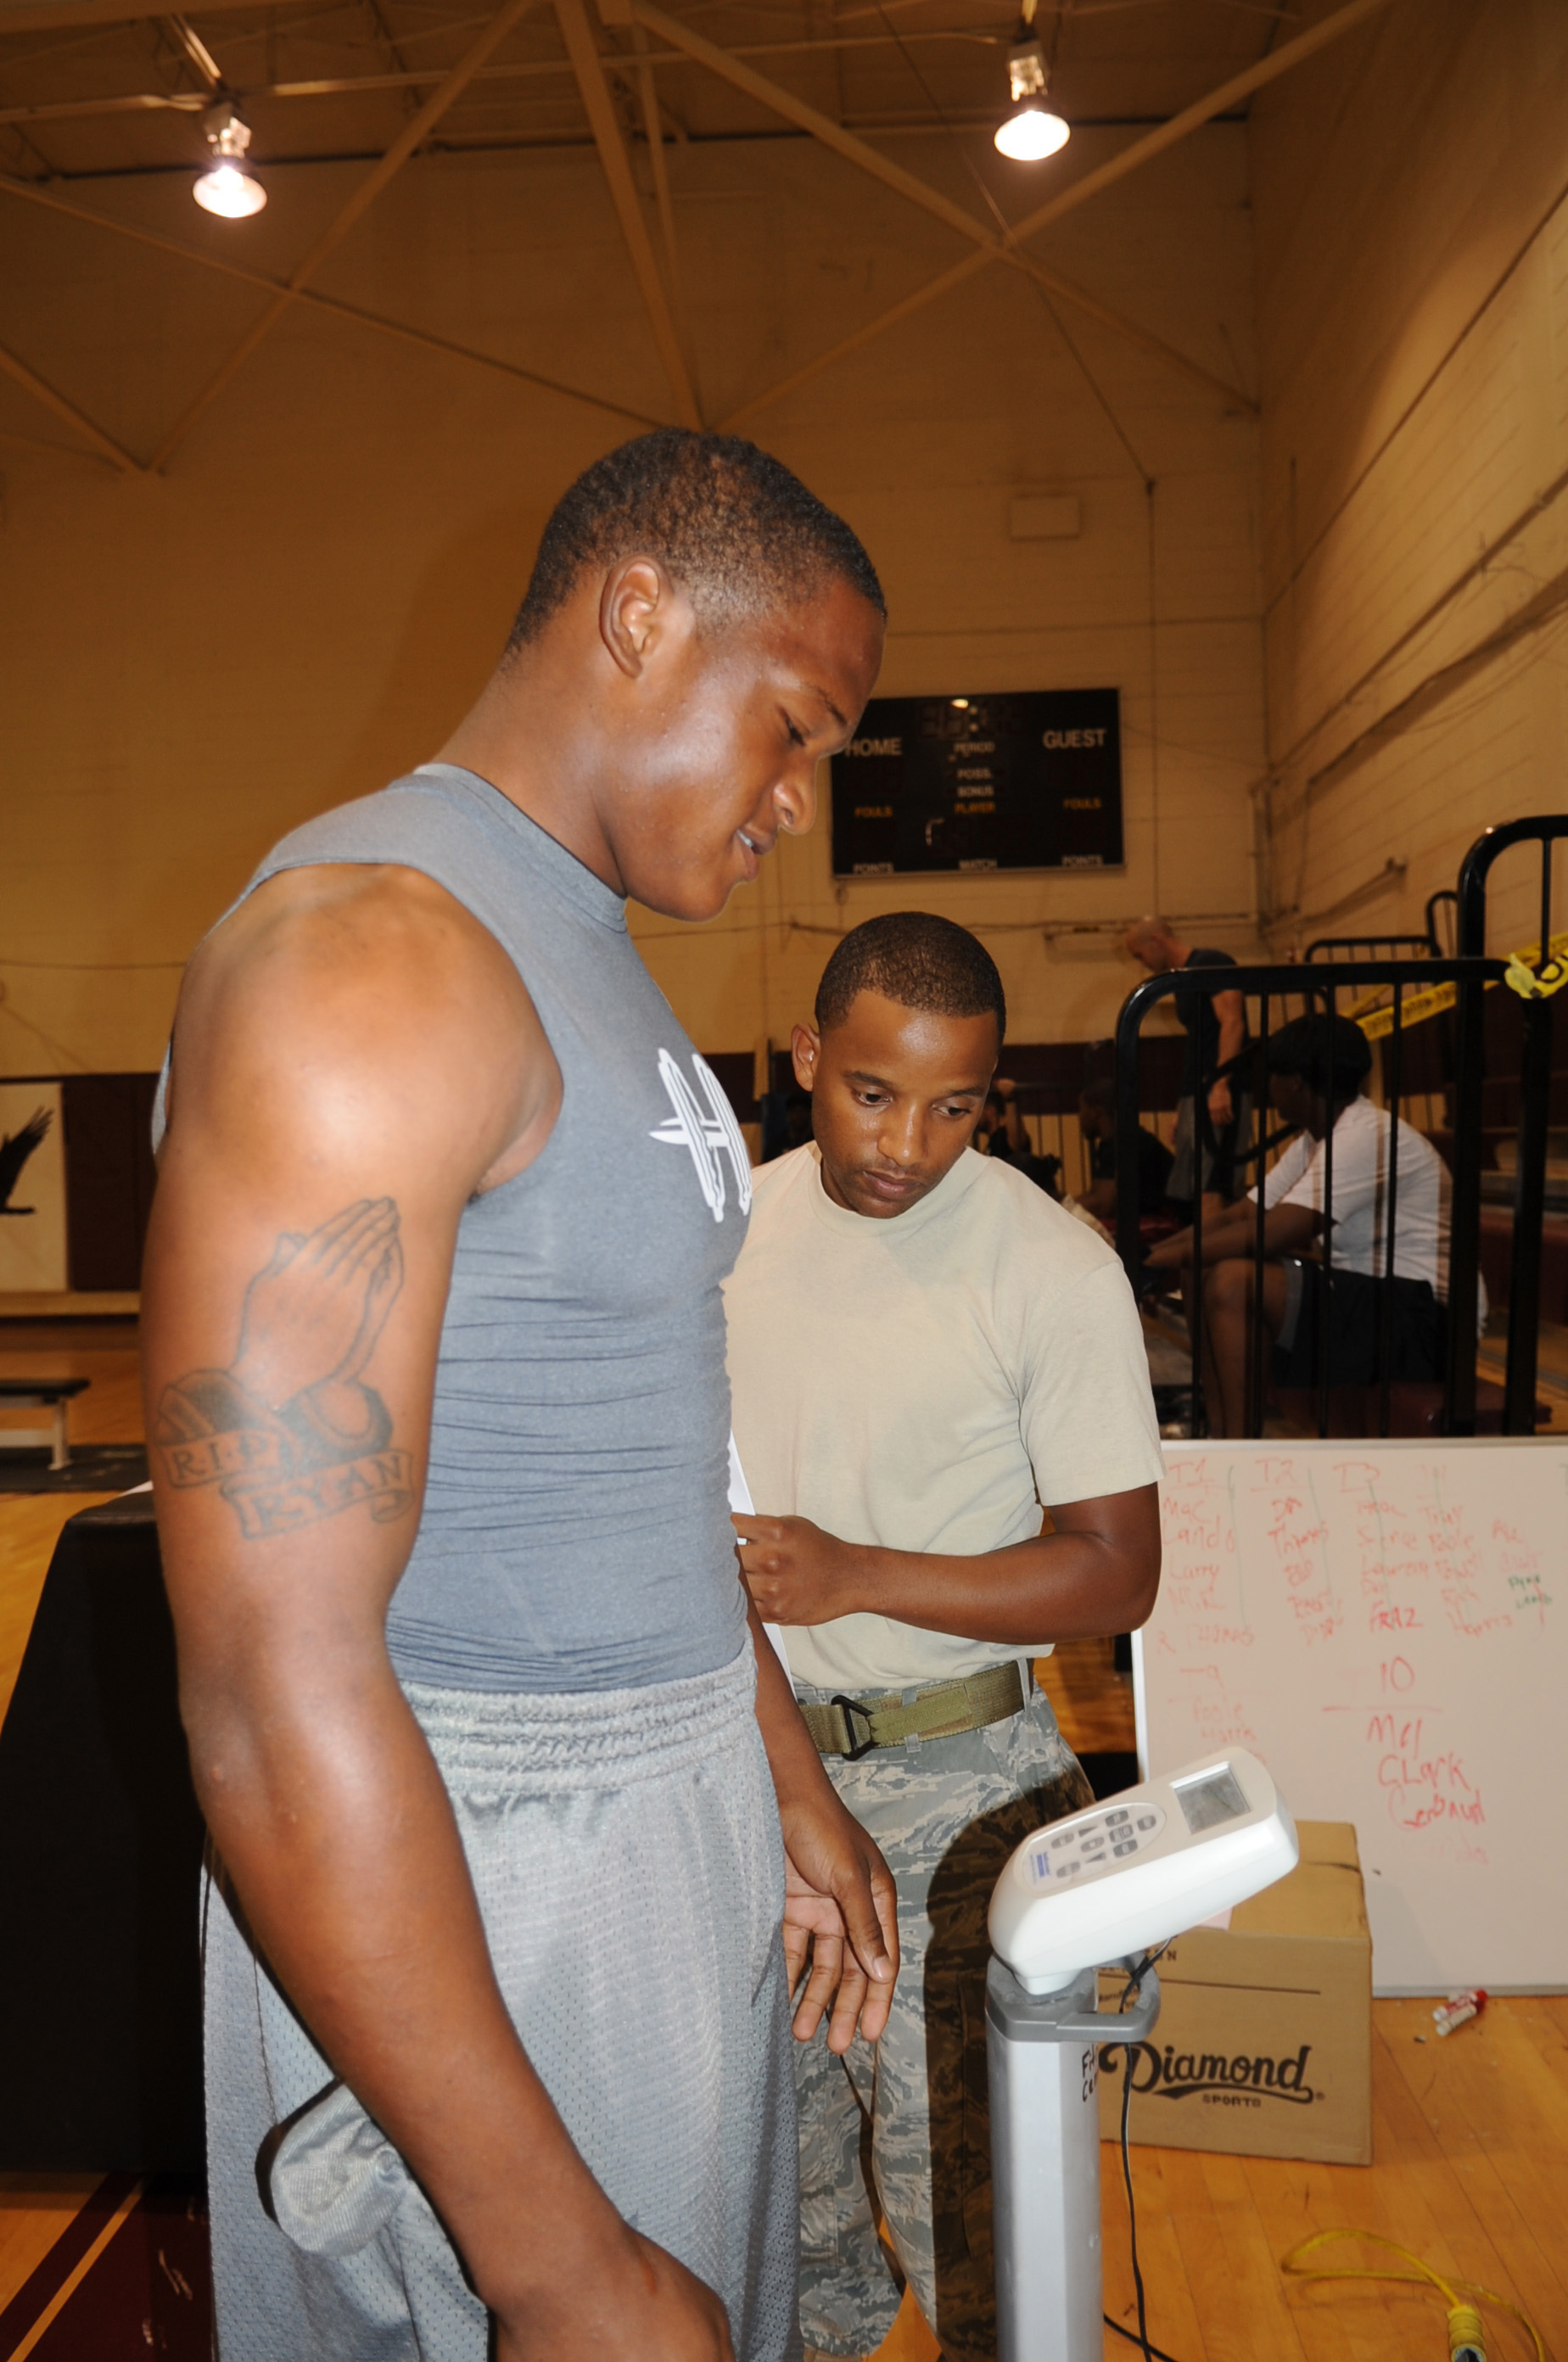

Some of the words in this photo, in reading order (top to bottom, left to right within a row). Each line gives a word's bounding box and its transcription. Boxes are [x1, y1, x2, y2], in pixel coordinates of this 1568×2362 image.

[1043, 728, 1106, 750] GUEST
[846, 737, 902, 757] HOME
[954, 741, 995, 753] PERIOD
[957, 786, 994, 798] BONUS
[955, 802, 995, 814] PLAYER
[1063, 798, 1101, 809] FOULS
[854, 807, 893, 818] FOULS
[1062, 855, 1102, 868] POINTS
[854, 862, 893, 875] POINTS
[1255, 1458, 1296, 1485] T2
[253, 1453, 402, 1527] RYAN
[1098, 2040, 1313, 2104] Diamond
[1202, 2094, 1261, 2108] SPORTS
